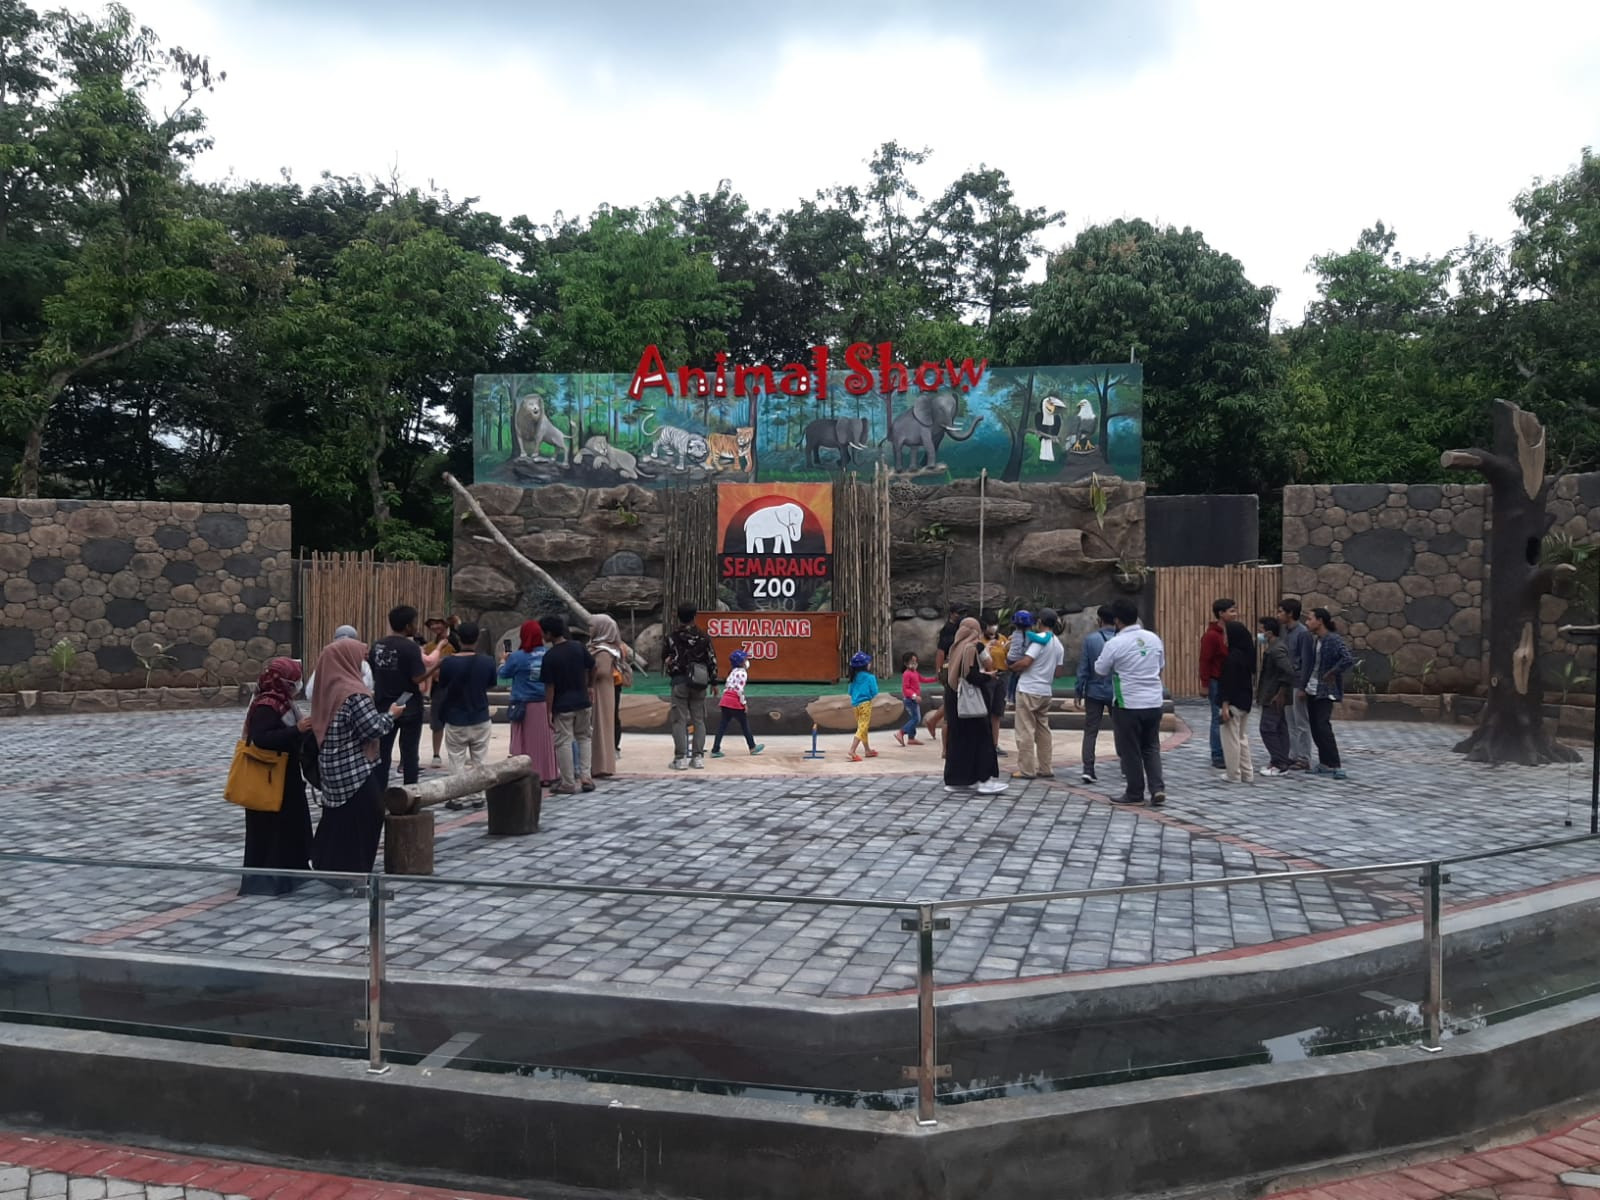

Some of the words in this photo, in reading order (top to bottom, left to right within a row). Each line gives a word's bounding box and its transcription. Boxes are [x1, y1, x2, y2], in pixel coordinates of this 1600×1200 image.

[628, 344, 829, 400] Animal
[844, 341, 989, 395] Show
[722, 557, 827, 577] SEMARANG
[752, 577, 796, 598] ZOO
[707, 618, 811, 637] SEMARANG
[741, 641, 778, 659] ZOO
